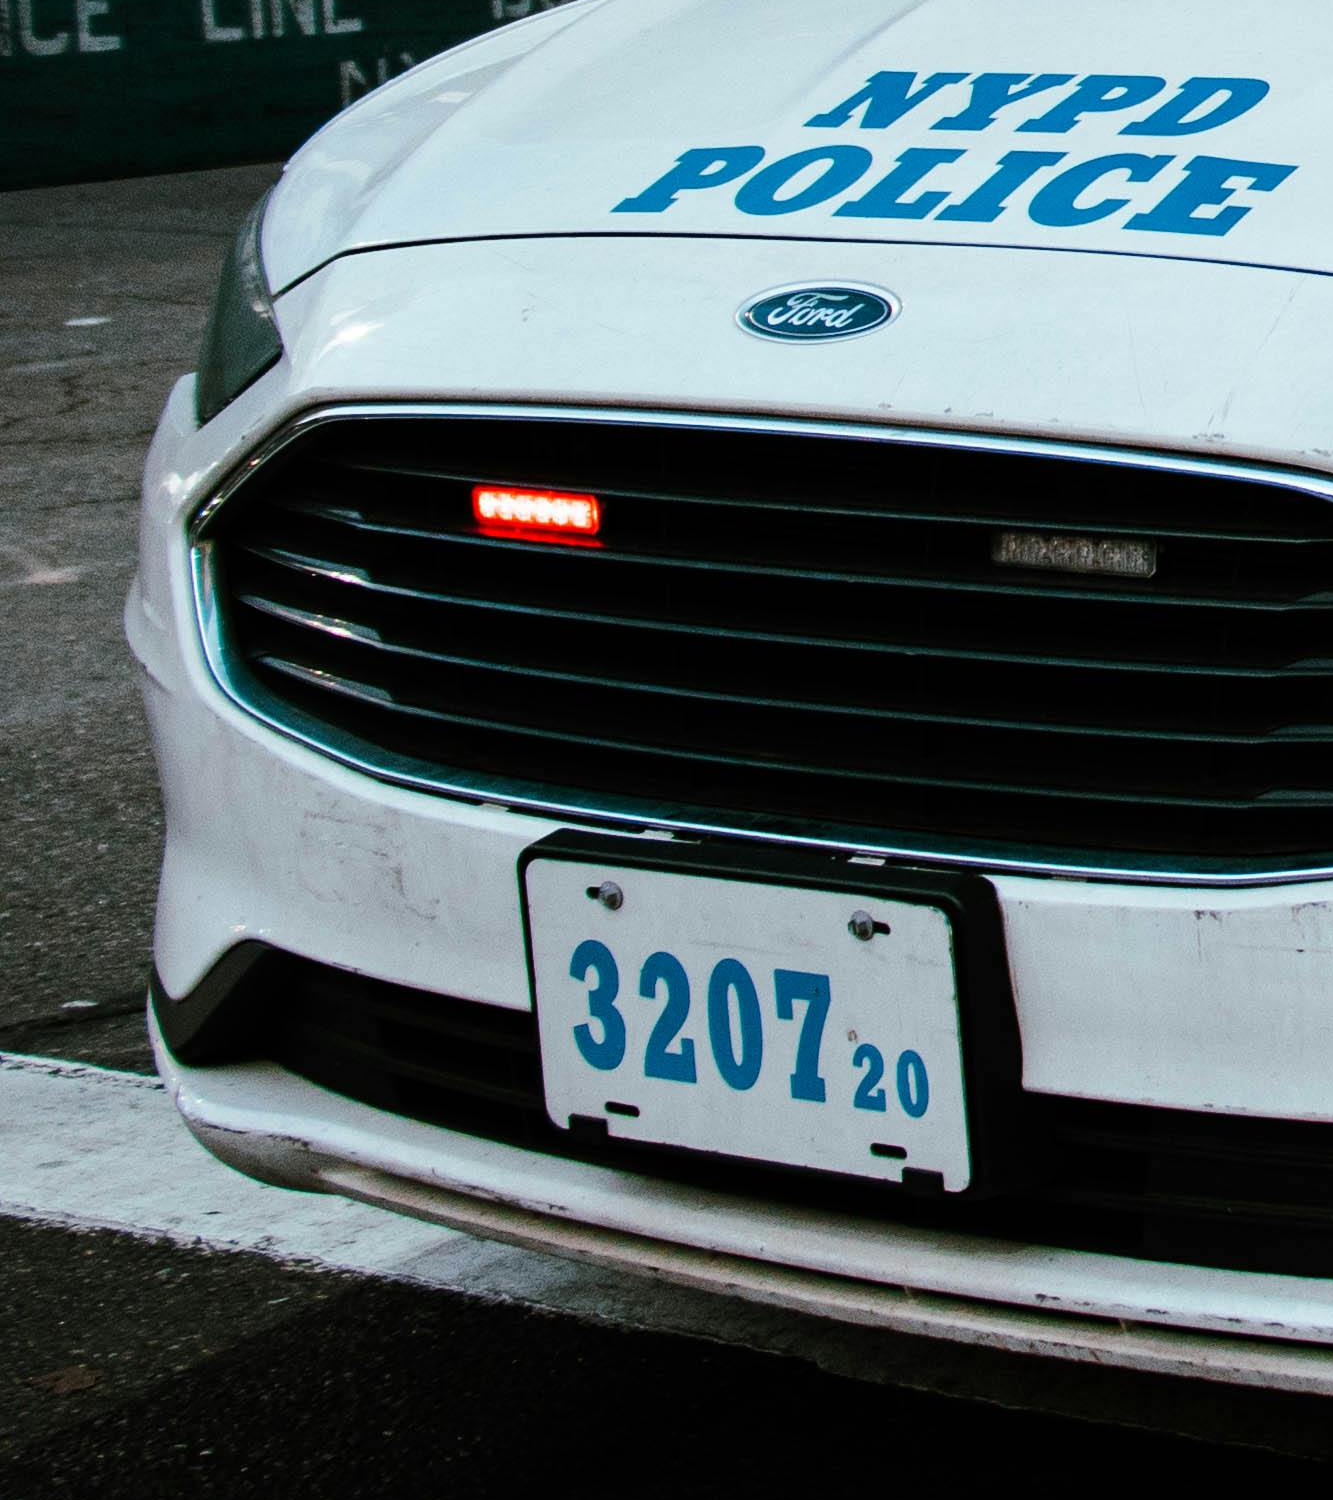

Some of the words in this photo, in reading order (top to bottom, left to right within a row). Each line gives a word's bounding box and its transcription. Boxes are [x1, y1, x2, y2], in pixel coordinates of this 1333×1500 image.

[803, 69, 1271, 138] NYPD
[611, 144, 1300, 238] POLICE
[766, 293, 866, 329] Ford
[568, 938, 831, 1104] 3207
[852, 1042, 930, 1119] 20
